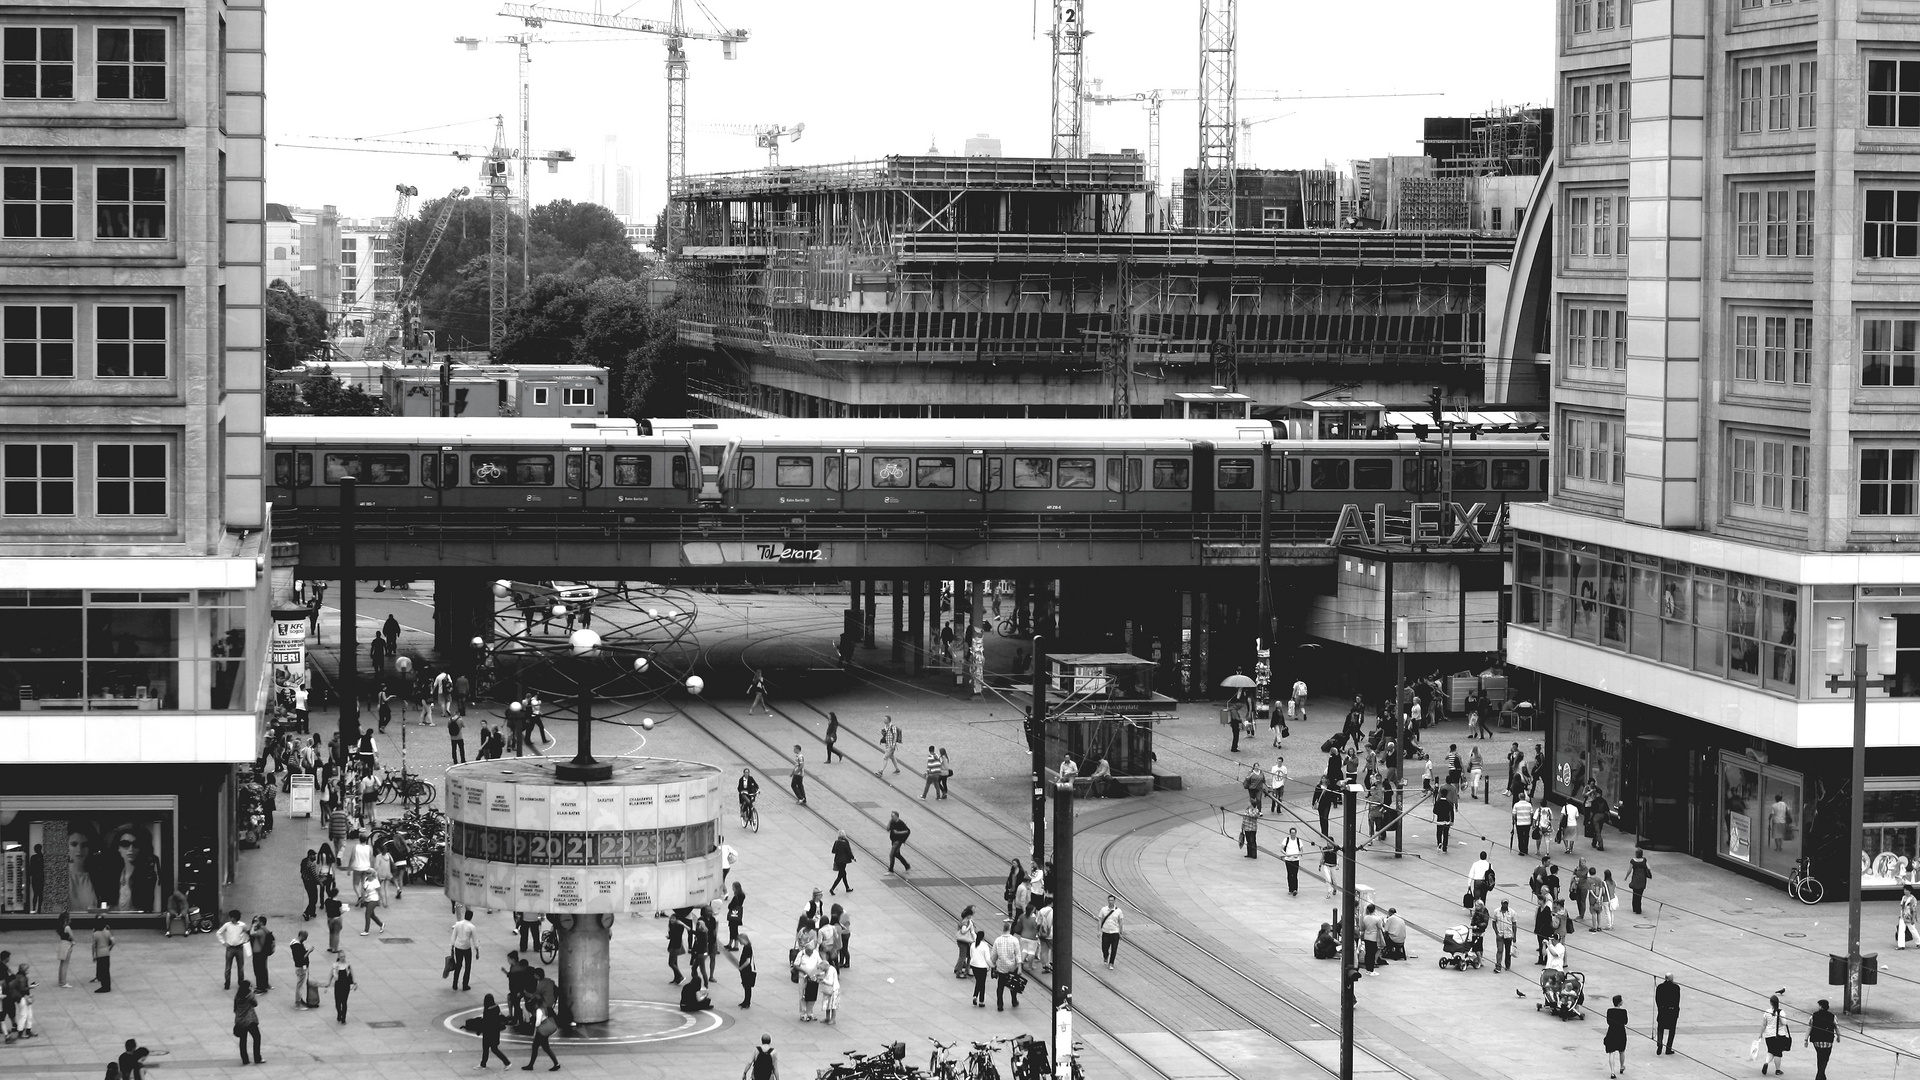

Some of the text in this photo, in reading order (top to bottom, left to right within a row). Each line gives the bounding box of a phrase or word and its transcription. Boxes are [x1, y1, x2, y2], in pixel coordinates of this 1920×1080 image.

[1066, 8, 1075, 22] 2
[480, 832, 497, 854] 18
[504, 835, 526, 856] 19
[532, 836, 562, 858] 20
[567, 837, 592, 858] 21
[600, 837, 631, 858] 22
[636, 835, 661, 856] 23
[666, 832, 686, 854] 24
